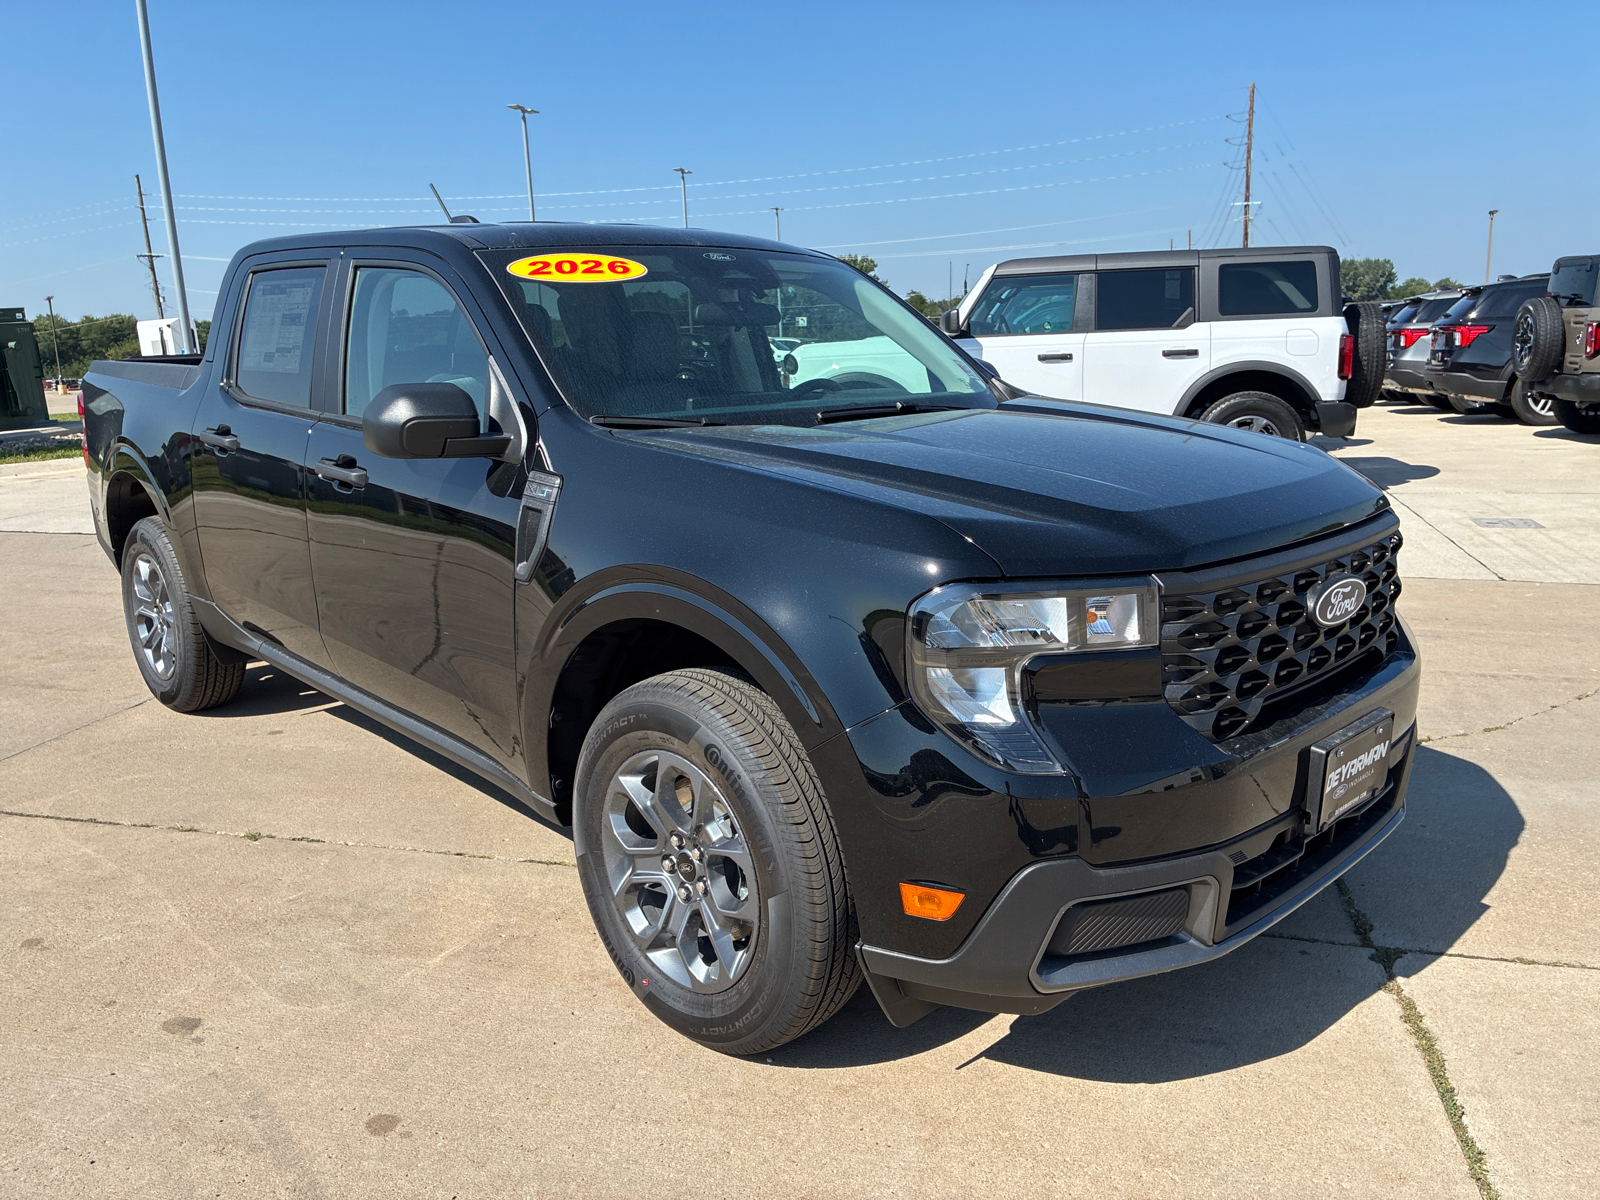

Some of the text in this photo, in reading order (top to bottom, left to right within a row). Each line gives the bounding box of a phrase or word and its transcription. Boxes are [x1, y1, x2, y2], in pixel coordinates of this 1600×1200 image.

[527, 259, 631, 276] 2026
[527, 483, 553, 497] XLT
[1326, 585, 1359, 620] Ford
[1325, 740, 1390, 794] DEYARMAN
[1348, 768, 1375, 789] INDIANOLA
[704, 743, 773, 855] Continental
